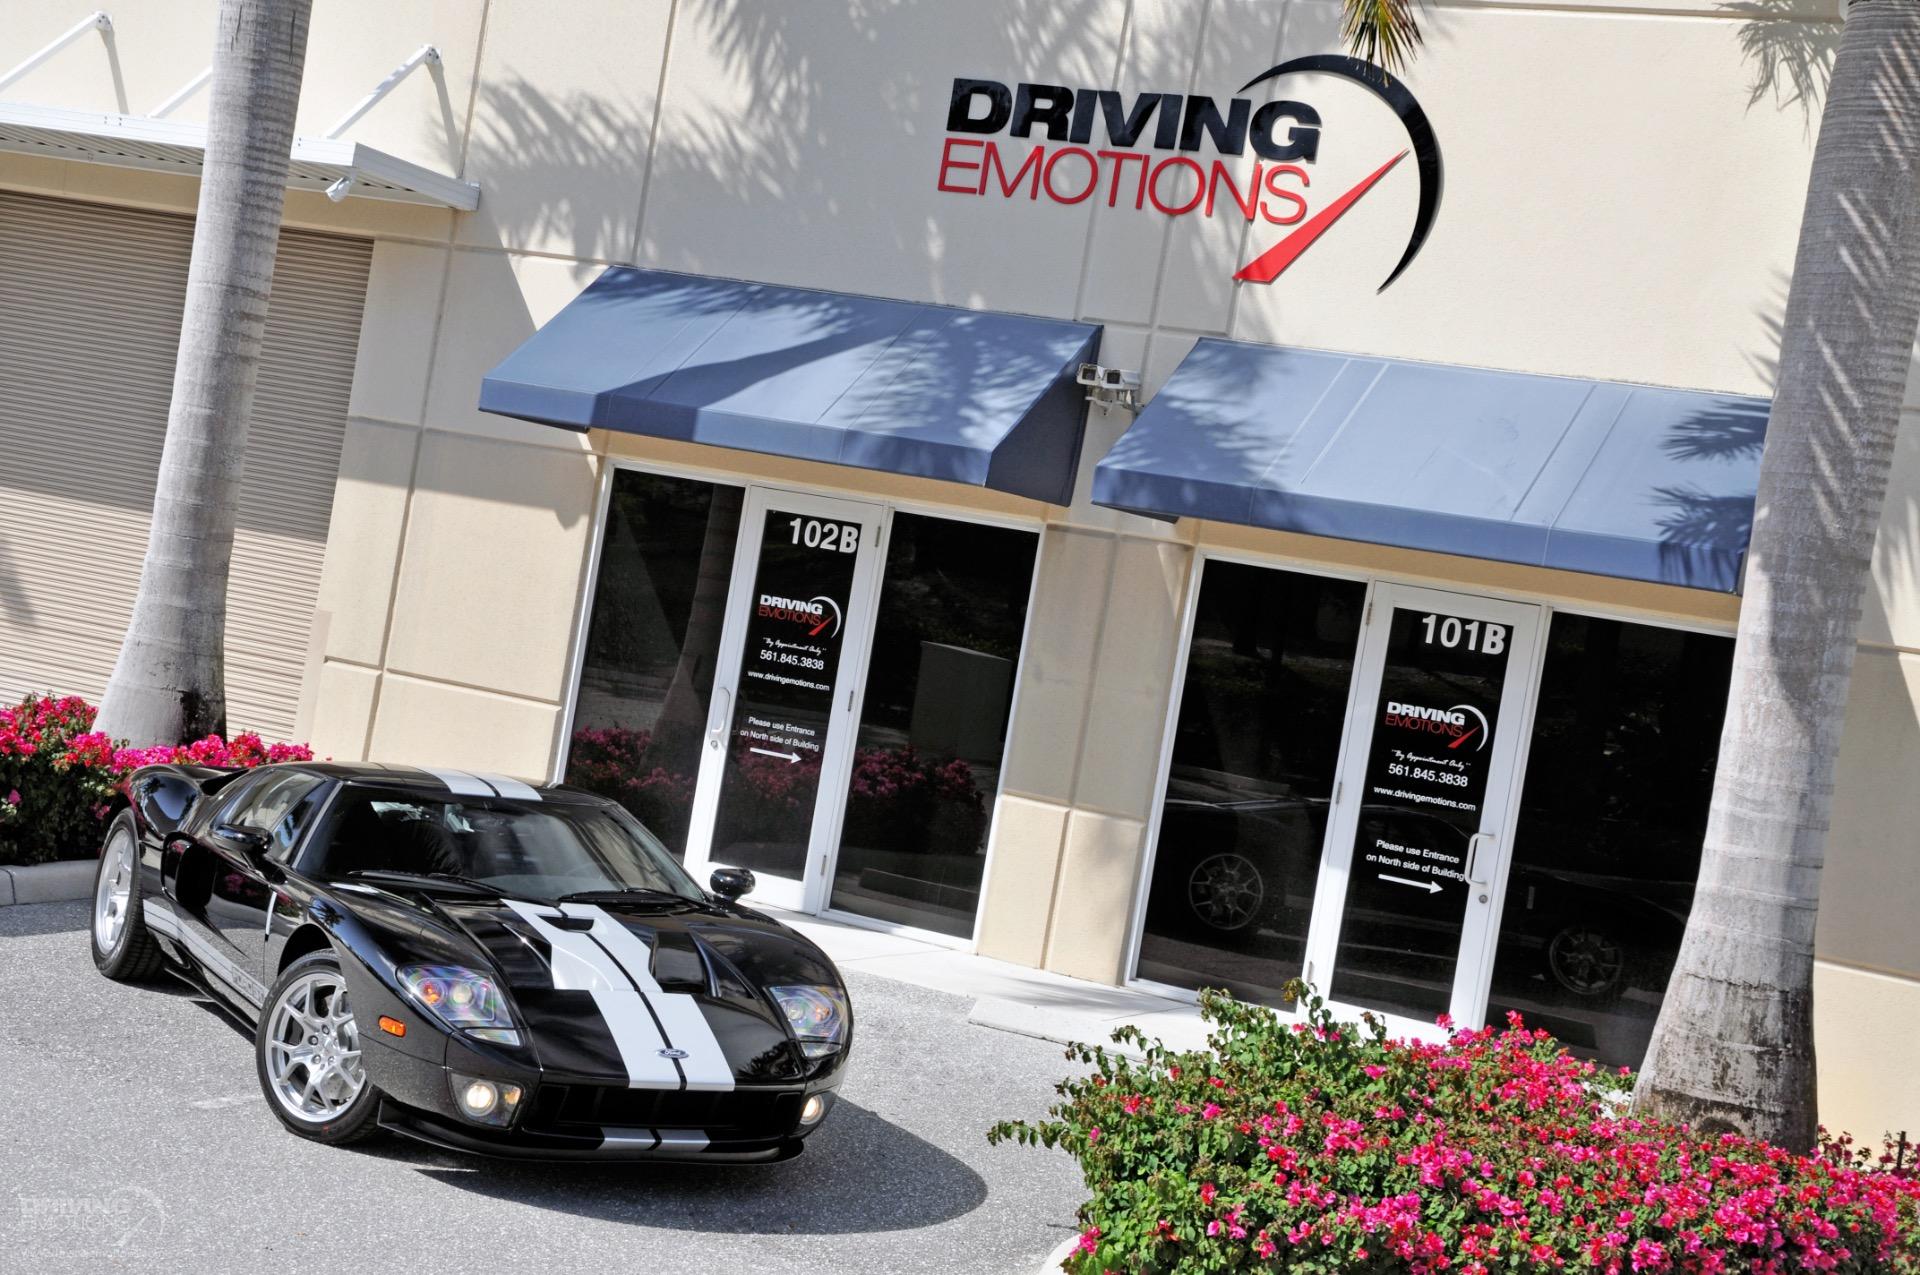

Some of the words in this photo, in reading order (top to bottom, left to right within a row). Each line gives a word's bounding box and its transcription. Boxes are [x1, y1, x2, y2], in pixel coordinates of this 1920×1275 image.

[946, 77, 1322, 163] DRIVING
[937, 137, 1310, 225] EMOTIONS
[789, 517, 859, 554] 102B
[758, 605, 821, 626] EMOTIONS
[760, 594, 823, 615] DRIVING
[1422, 614, 1506, 655] 101B
[760, 649, 825, 670] 561.845.3838
[747, 670, 830, 691] www.drivingemotions.com
[1384, 713, 1464, 737] EMOTIONS
[1386, 701, 1466, 726] DRIVING
[748, 716, 771, 728] Please
[785, 723, 816, 737] Entrance
[750, 730, 769, 741] North
[769, 734, 784, 744] side
[792, 738, 820, 753] Building
[1406, 752, 1449, 763] Appointment
[1388, 763, 1469, 787] 561.845.3838
[1373, 786, 1477, 811] www.drivingemotions.com
[1376, 839, 1405, 853] Please
[1405, 847, 1421, 856] use
[1422, 848, 1460, 864] Entrance
[1365, 854, 1377, 862] on
[1378, 854, 1402, 867] North
[1402, 860, 1420, 871] side
[1421, 865, 1431, 873] of
[1431, 865, 1466, 882] Building
